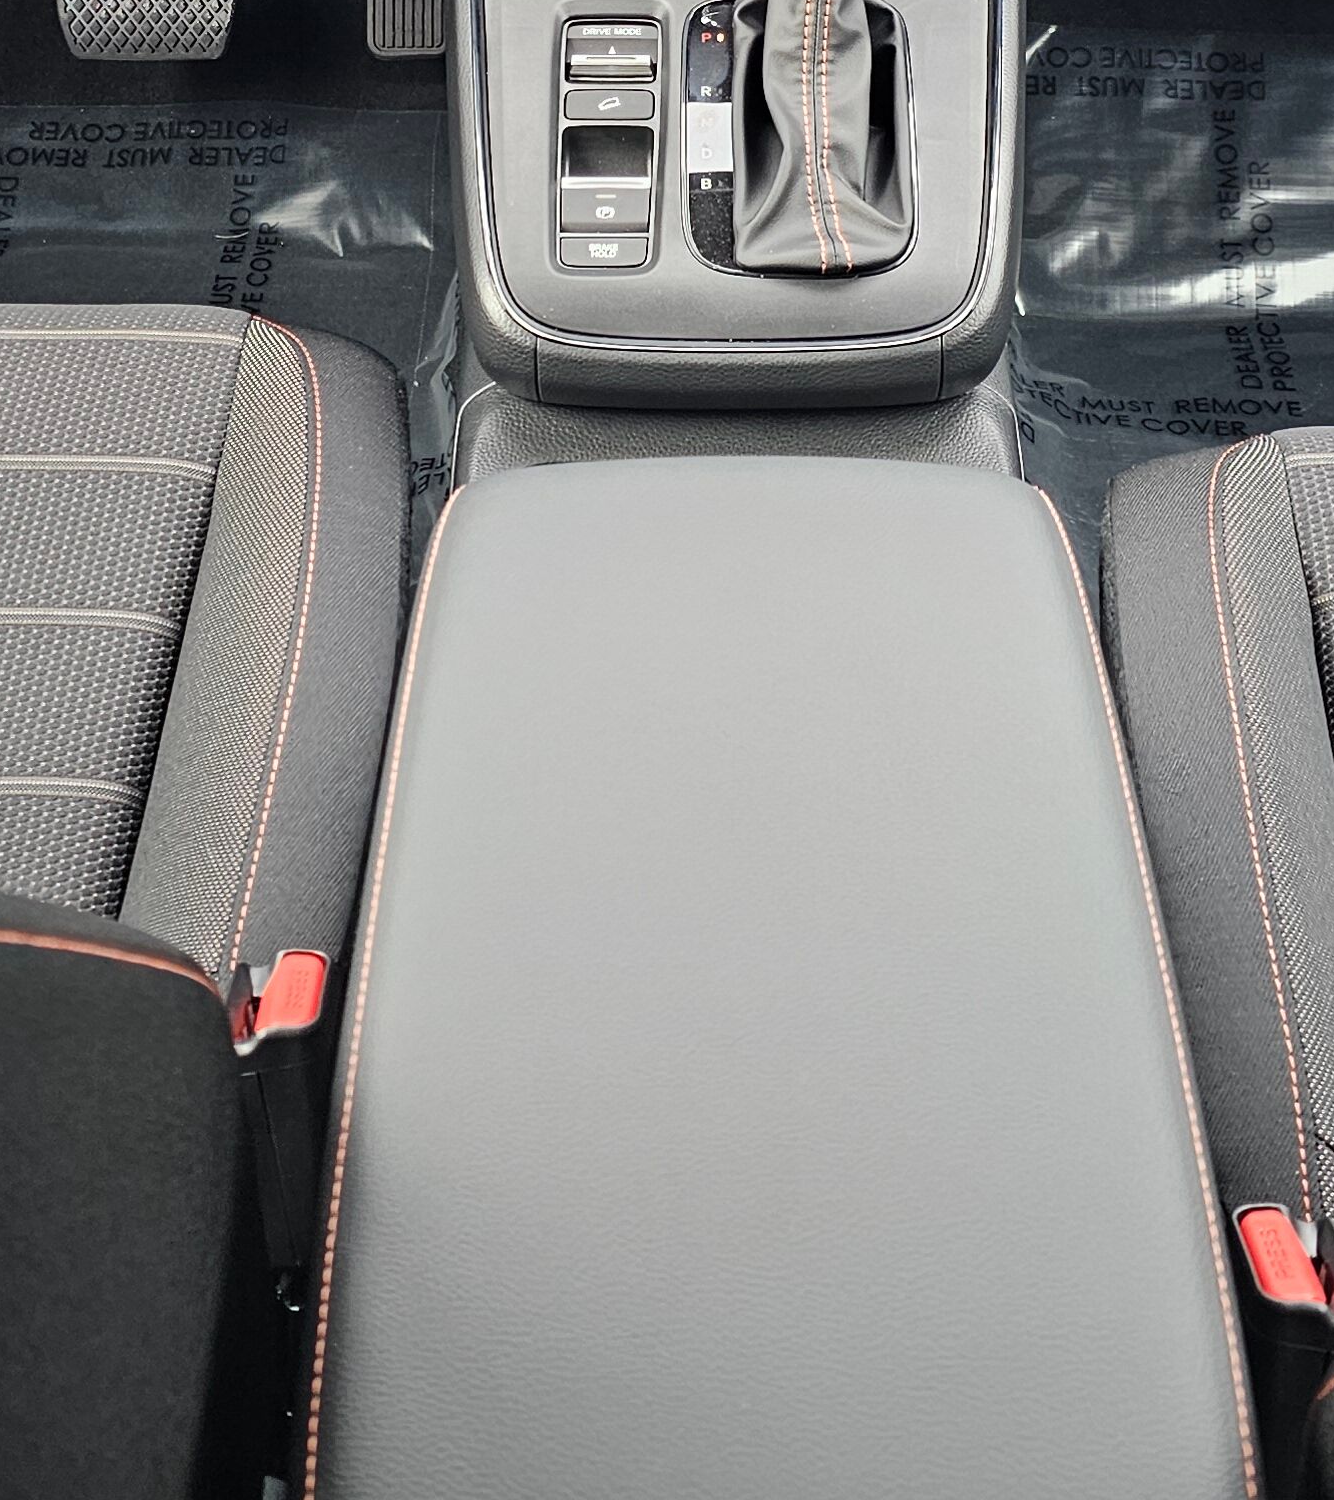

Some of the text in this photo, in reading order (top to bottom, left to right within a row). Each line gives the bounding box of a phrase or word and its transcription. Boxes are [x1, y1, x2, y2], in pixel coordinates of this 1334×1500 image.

[582, 27, 643, 36] DRIVE MODE
[701, 32, 712, 43] P
[1099, 46, 1267, 72] PROTECTIVE
[700, 86, 712, 97] R
[1075, 74, 1146, 98] MUST
[1162, 79, 1267, 101] DEALER
[28, 119, 289, 142] PROTECTIVE COVER
[102, 146, 172, 169] MUST
[188, 145, 287, 167] DEALER
[700, 178, 713, 190] B
[219, 172, 257, 264] REMOVE
[1248, 159, 1274, 257] COVER
[247, 220, 282, 287] COVER
[588, 243, 619, 251] BRAKE
[590, 250, 618, 258] HOLD
[1213, 108, 1264, 390] DEALER REMOVE
[1080, 396, 1304, 418] MUST REMOVE
[1140, 417, 1248, 437] COVER
